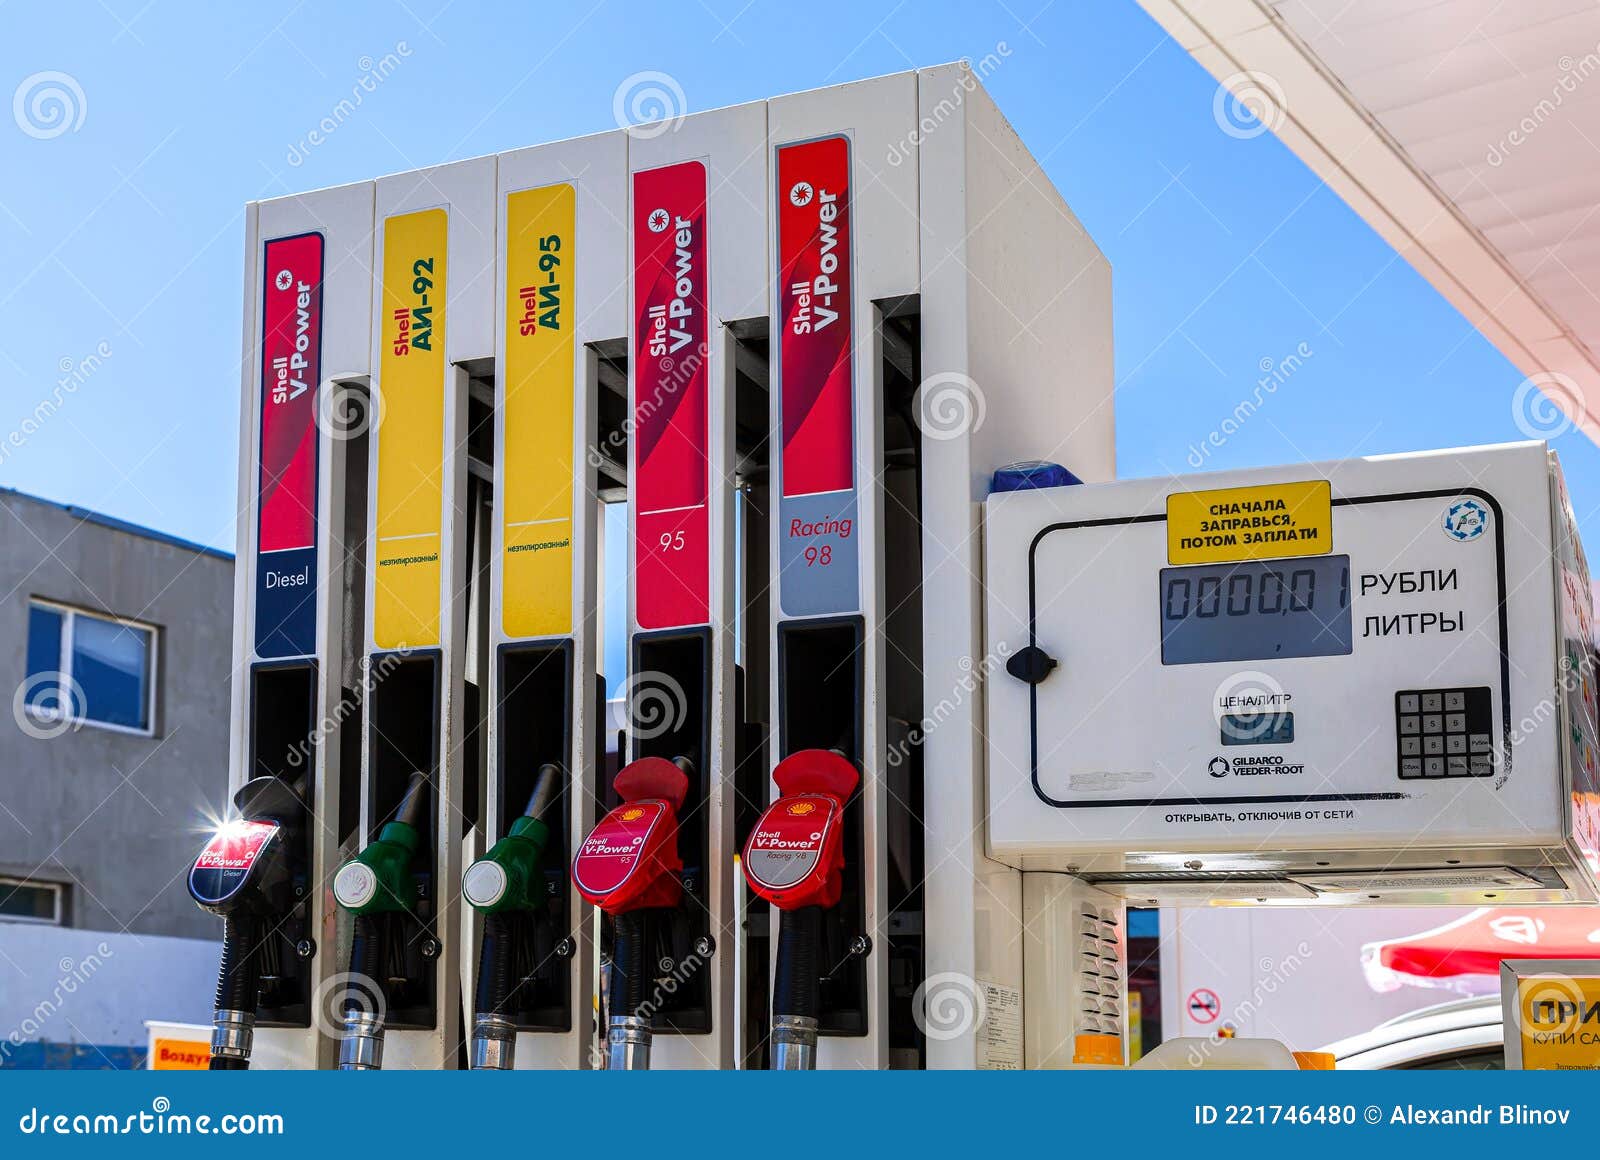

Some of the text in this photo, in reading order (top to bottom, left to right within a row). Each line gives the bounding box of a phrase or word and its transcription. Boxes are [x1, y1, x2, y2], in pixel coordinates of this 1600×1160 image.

[814, 189, 839, 332] V-Power
[538, 234, 561, 330] АИ-95
[669, 215, 692, 354] V-Power
[412, 257, 434, 351] АИ-92
[519, 286, 536, 337] Shell
[792, 281, 811, 335] Shell
[289, 280, 311, 400] V-Power
[394, 307, 410, 356] Shell
[649, 304, 667, 357] Shell
[272, 356, 288, 404] Shell
[1209, 499, 1286, 516] СНАЧАЛА
[790, 515, 852, 538] Racing
[1201, 514, 1296, 532] ЗАПРАВЬСЯ,
[660, 531, 685, 552] 95
[1181, 528, 1318, 549] ПОТОМ ЗАПЛАТИ
[804, 545, 832, 567] 98
[266, 565, 308, 589] Diesel
[1360, 568, 1457, 596] РУБЛИ
[1362, 610, 1464, 637] ЛИТРЫ
[1219, 694, 1292, 709] ЦЕНА/ЛИТР
[1452, 697, 1458, 705] 3
[1408, 742, 1413, 750] 7
[1233, 756, 1283, 766] GILBARCO
[1233, 765, 1304, 776] VEEDER-ROOT
[1165, 810, 1354, 823] ОТКРЫВАТЬ, ОТКЛЮЧИВ ОТ СЕТИ
[585, 845, 636, 855] V-Power
[587, 838, 608, 846] Shell
[756, 838, 815, 848] V-Power
[200, 856, 247, 867] V-Power
[620, 856, 632, 864] 95
[766, 851, 792, 861] Racing
[1533, 1032, 1575, 1045] КУПИ
